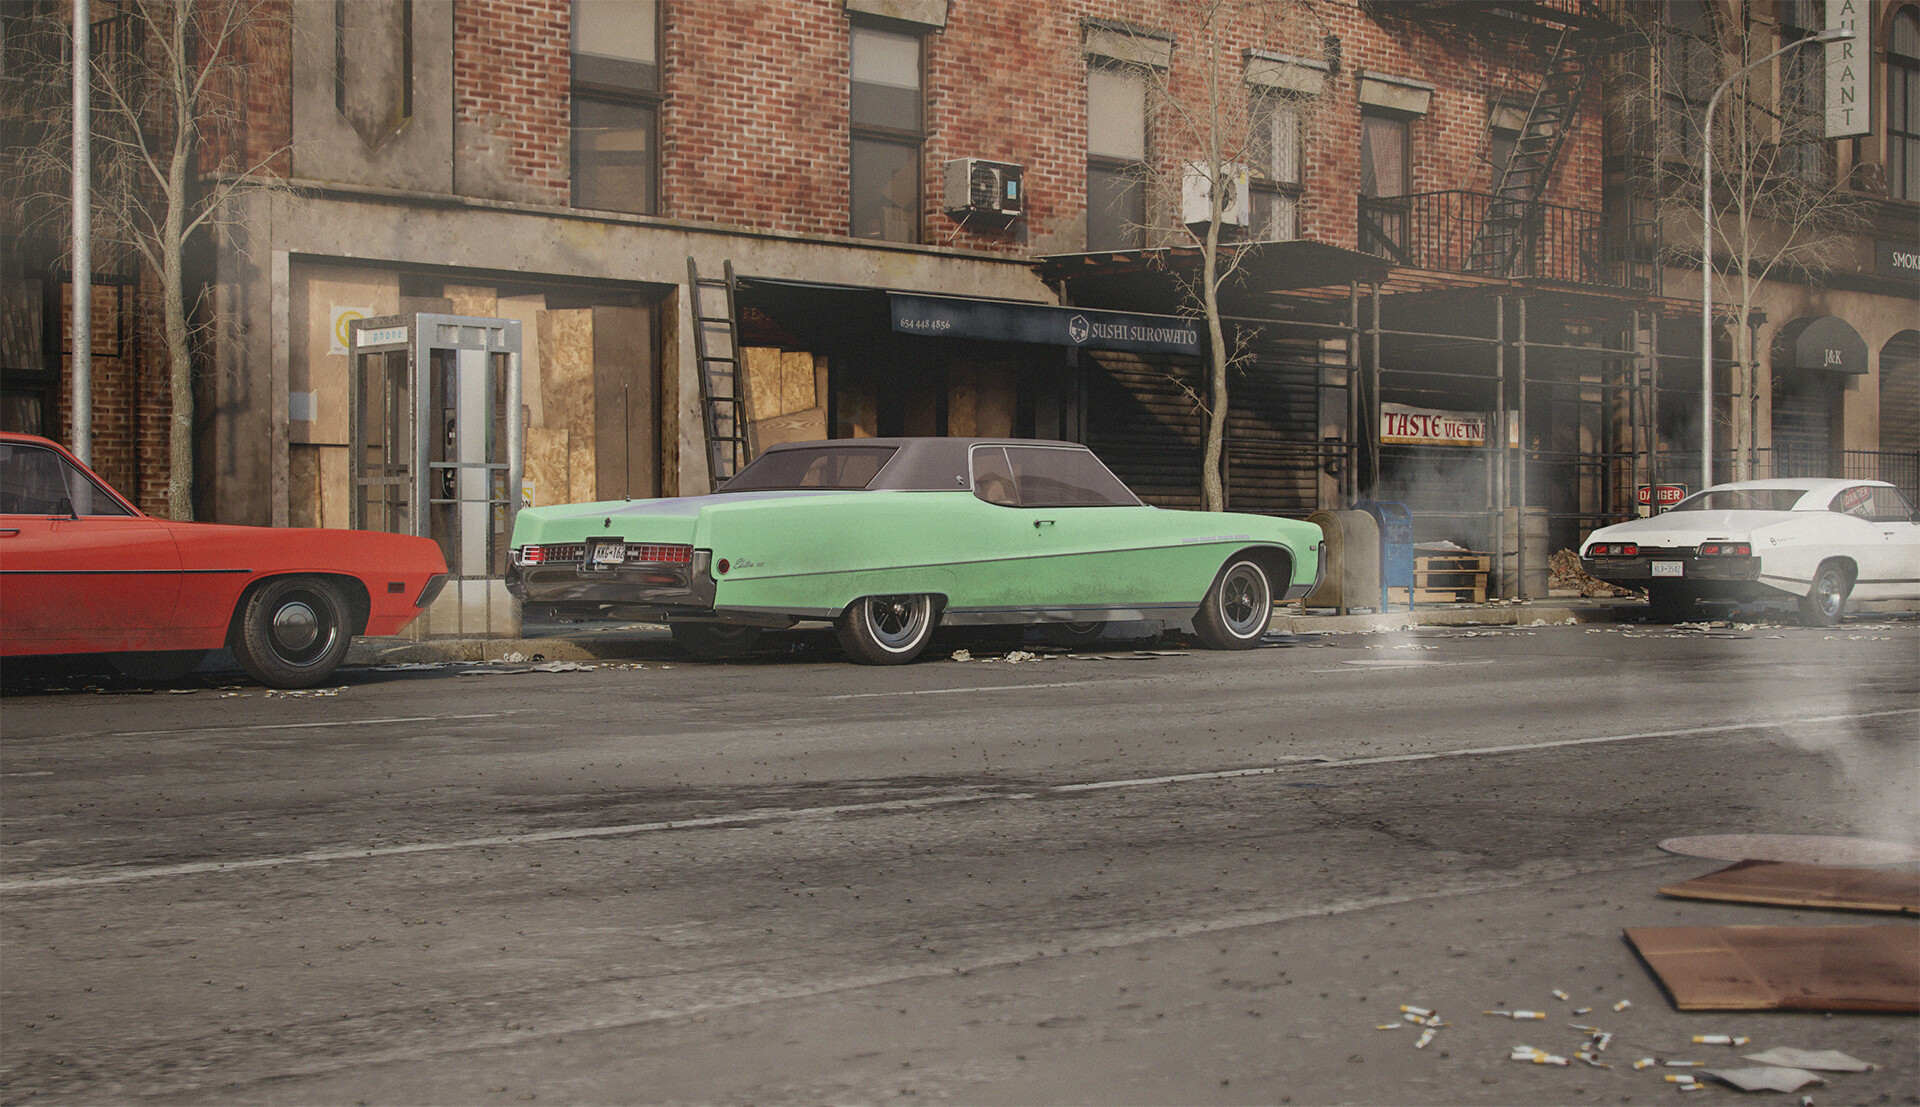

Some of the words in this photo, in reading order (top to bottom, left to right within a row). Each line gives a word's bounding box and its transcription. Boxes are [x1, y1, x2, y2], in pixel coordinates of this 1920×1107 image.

[1892, 251, 1920, 270] SMOK
[900, 317, 914, 329] 654
[916, 319, 930, 329] 448
[931, 319, 951, 331] 4856
[373, 330, 402, 343] phone
[1091, 323, 1129, 340] SUSHI
[1130, 326, 1198, 345] SUROWATO
[1823, 349, 1842, 367] J&K
[1384, 412, 1442, 437] TASTE
[1640, 490, 1680, 500] DAGER
